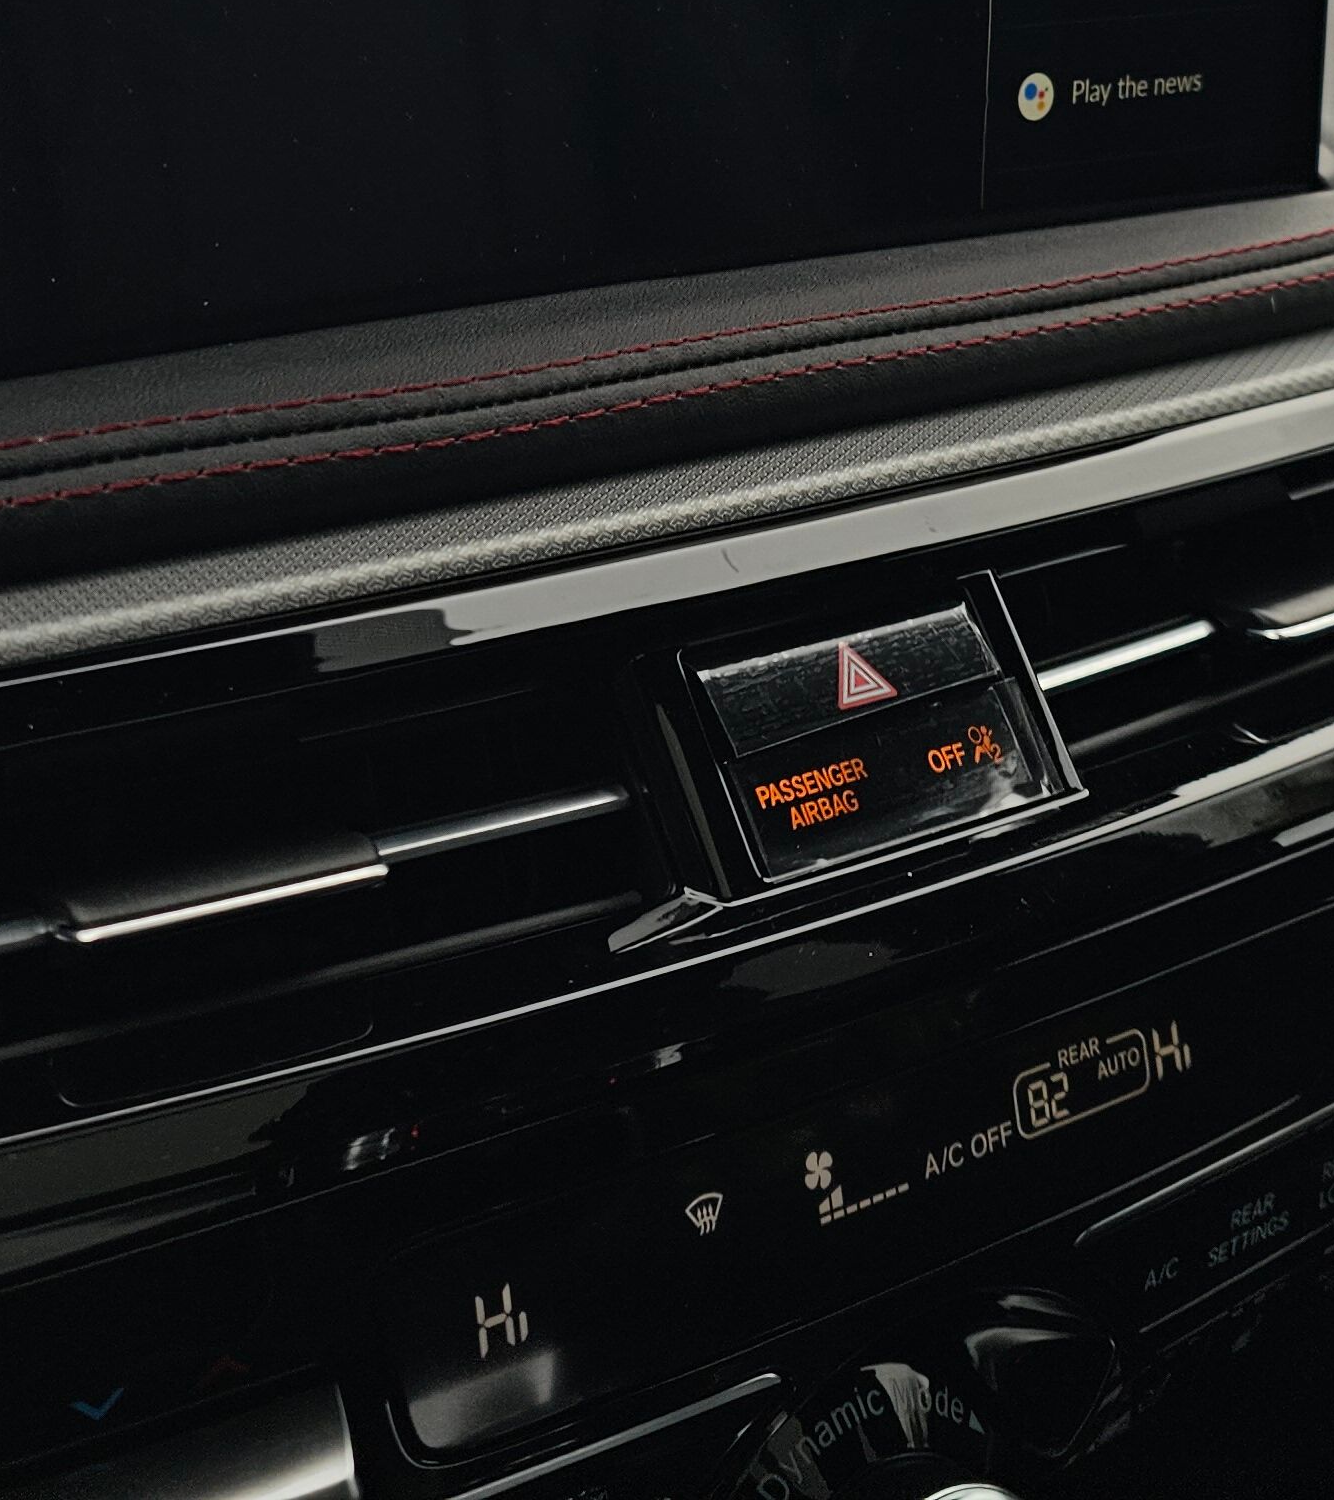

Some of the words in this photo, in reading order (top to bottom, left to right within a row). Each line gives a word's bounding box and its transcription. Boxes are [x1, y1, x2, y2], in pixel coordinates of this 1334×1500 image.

[1072, 79, 1112, 106] Play
[1118, 75, 1149, 100] the
[1154, 73, 1202, 95] news
[927, 741, 966, 774] OFF
[754, 757, 868, 809] PASSENGER
[788, 789, 860, 831] AIRBAG
[1056, 1035, 1101, 1070] REAR
[1096, 1046, 1141, 1081] AUTO
[1026, 1070, 1071, 1129] 82
[924, 1140, 965, 1180] A/C
[970, 1119, 1014, 1160] OFF
[1230, 1191, 1277, 1231] REAR
[1207, 1209, 1291, 1269] SETTINGS
[1144, 1256, 1179, 1291] A/C
